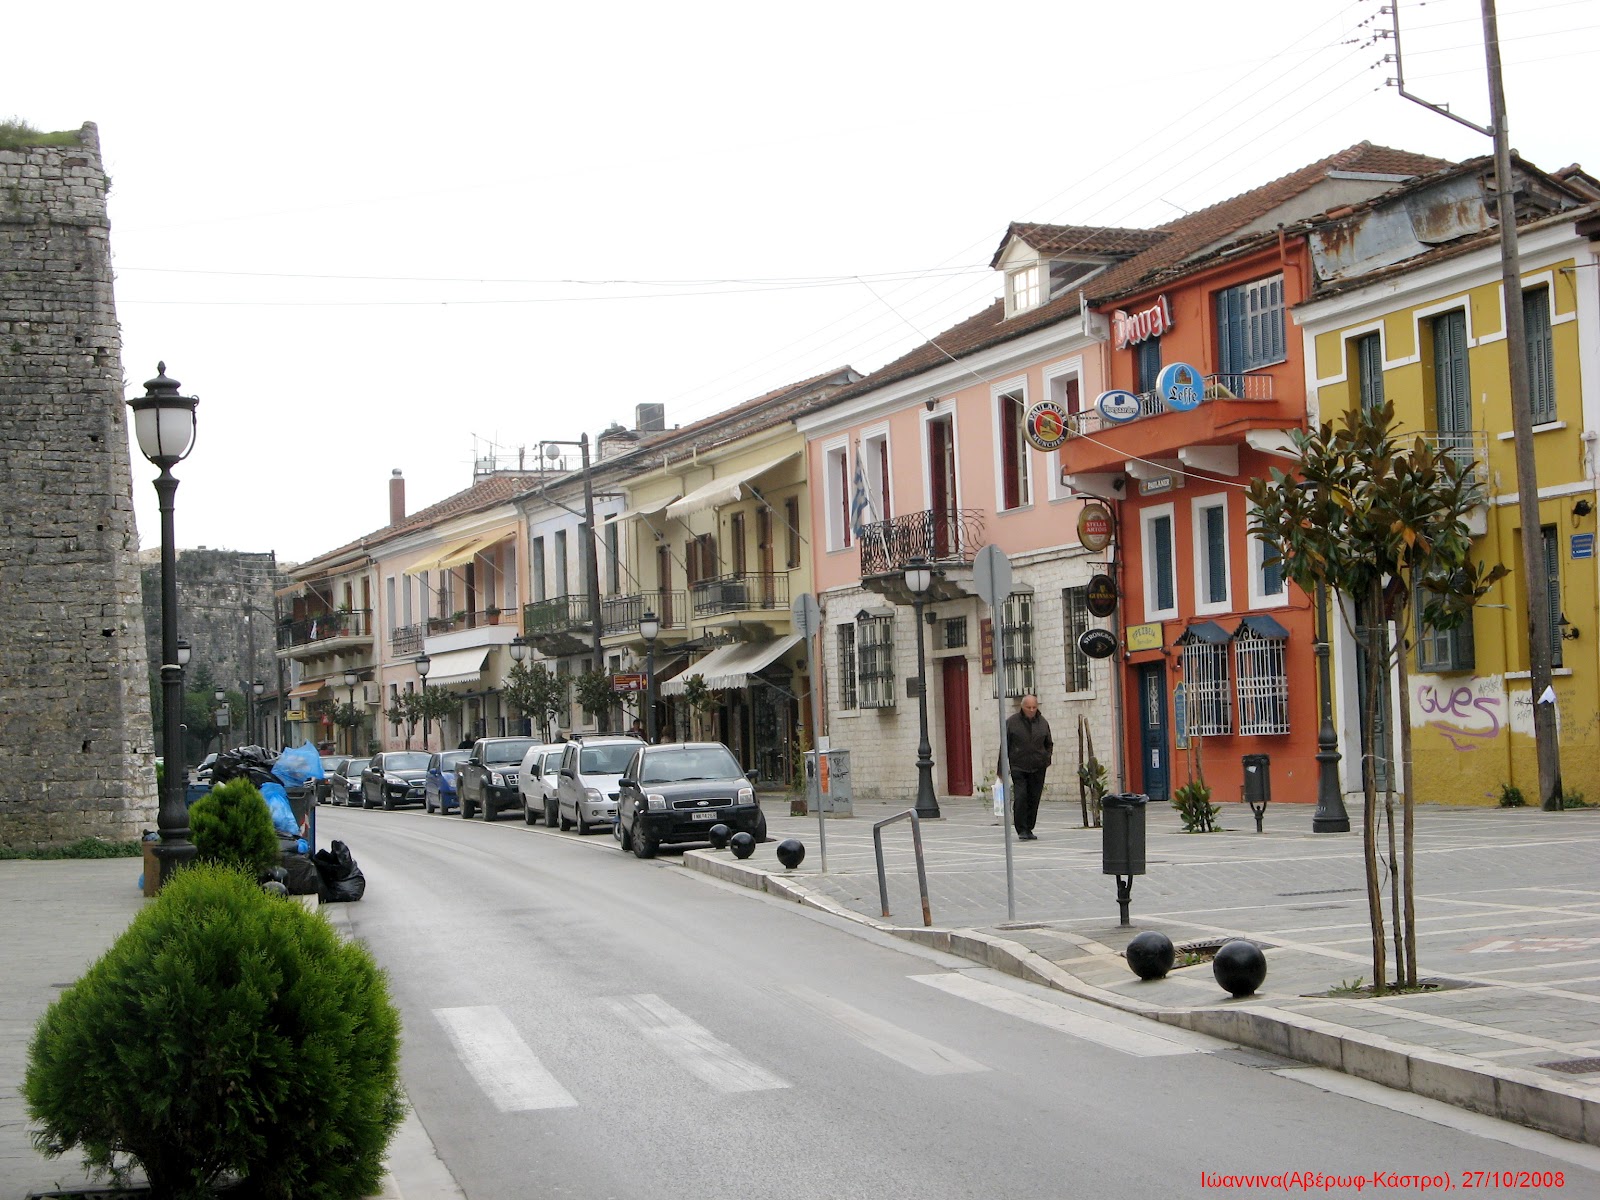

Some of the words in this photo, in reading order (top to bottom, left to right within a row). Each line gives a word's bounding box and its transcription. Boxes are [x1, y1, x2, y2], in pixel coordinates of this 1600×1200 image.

[1169, 386, 1197, 404] Leffe
[1029, 403, 1067, 422] PAULANER
[1103, 404, 1137, 414] Hoegaarden
